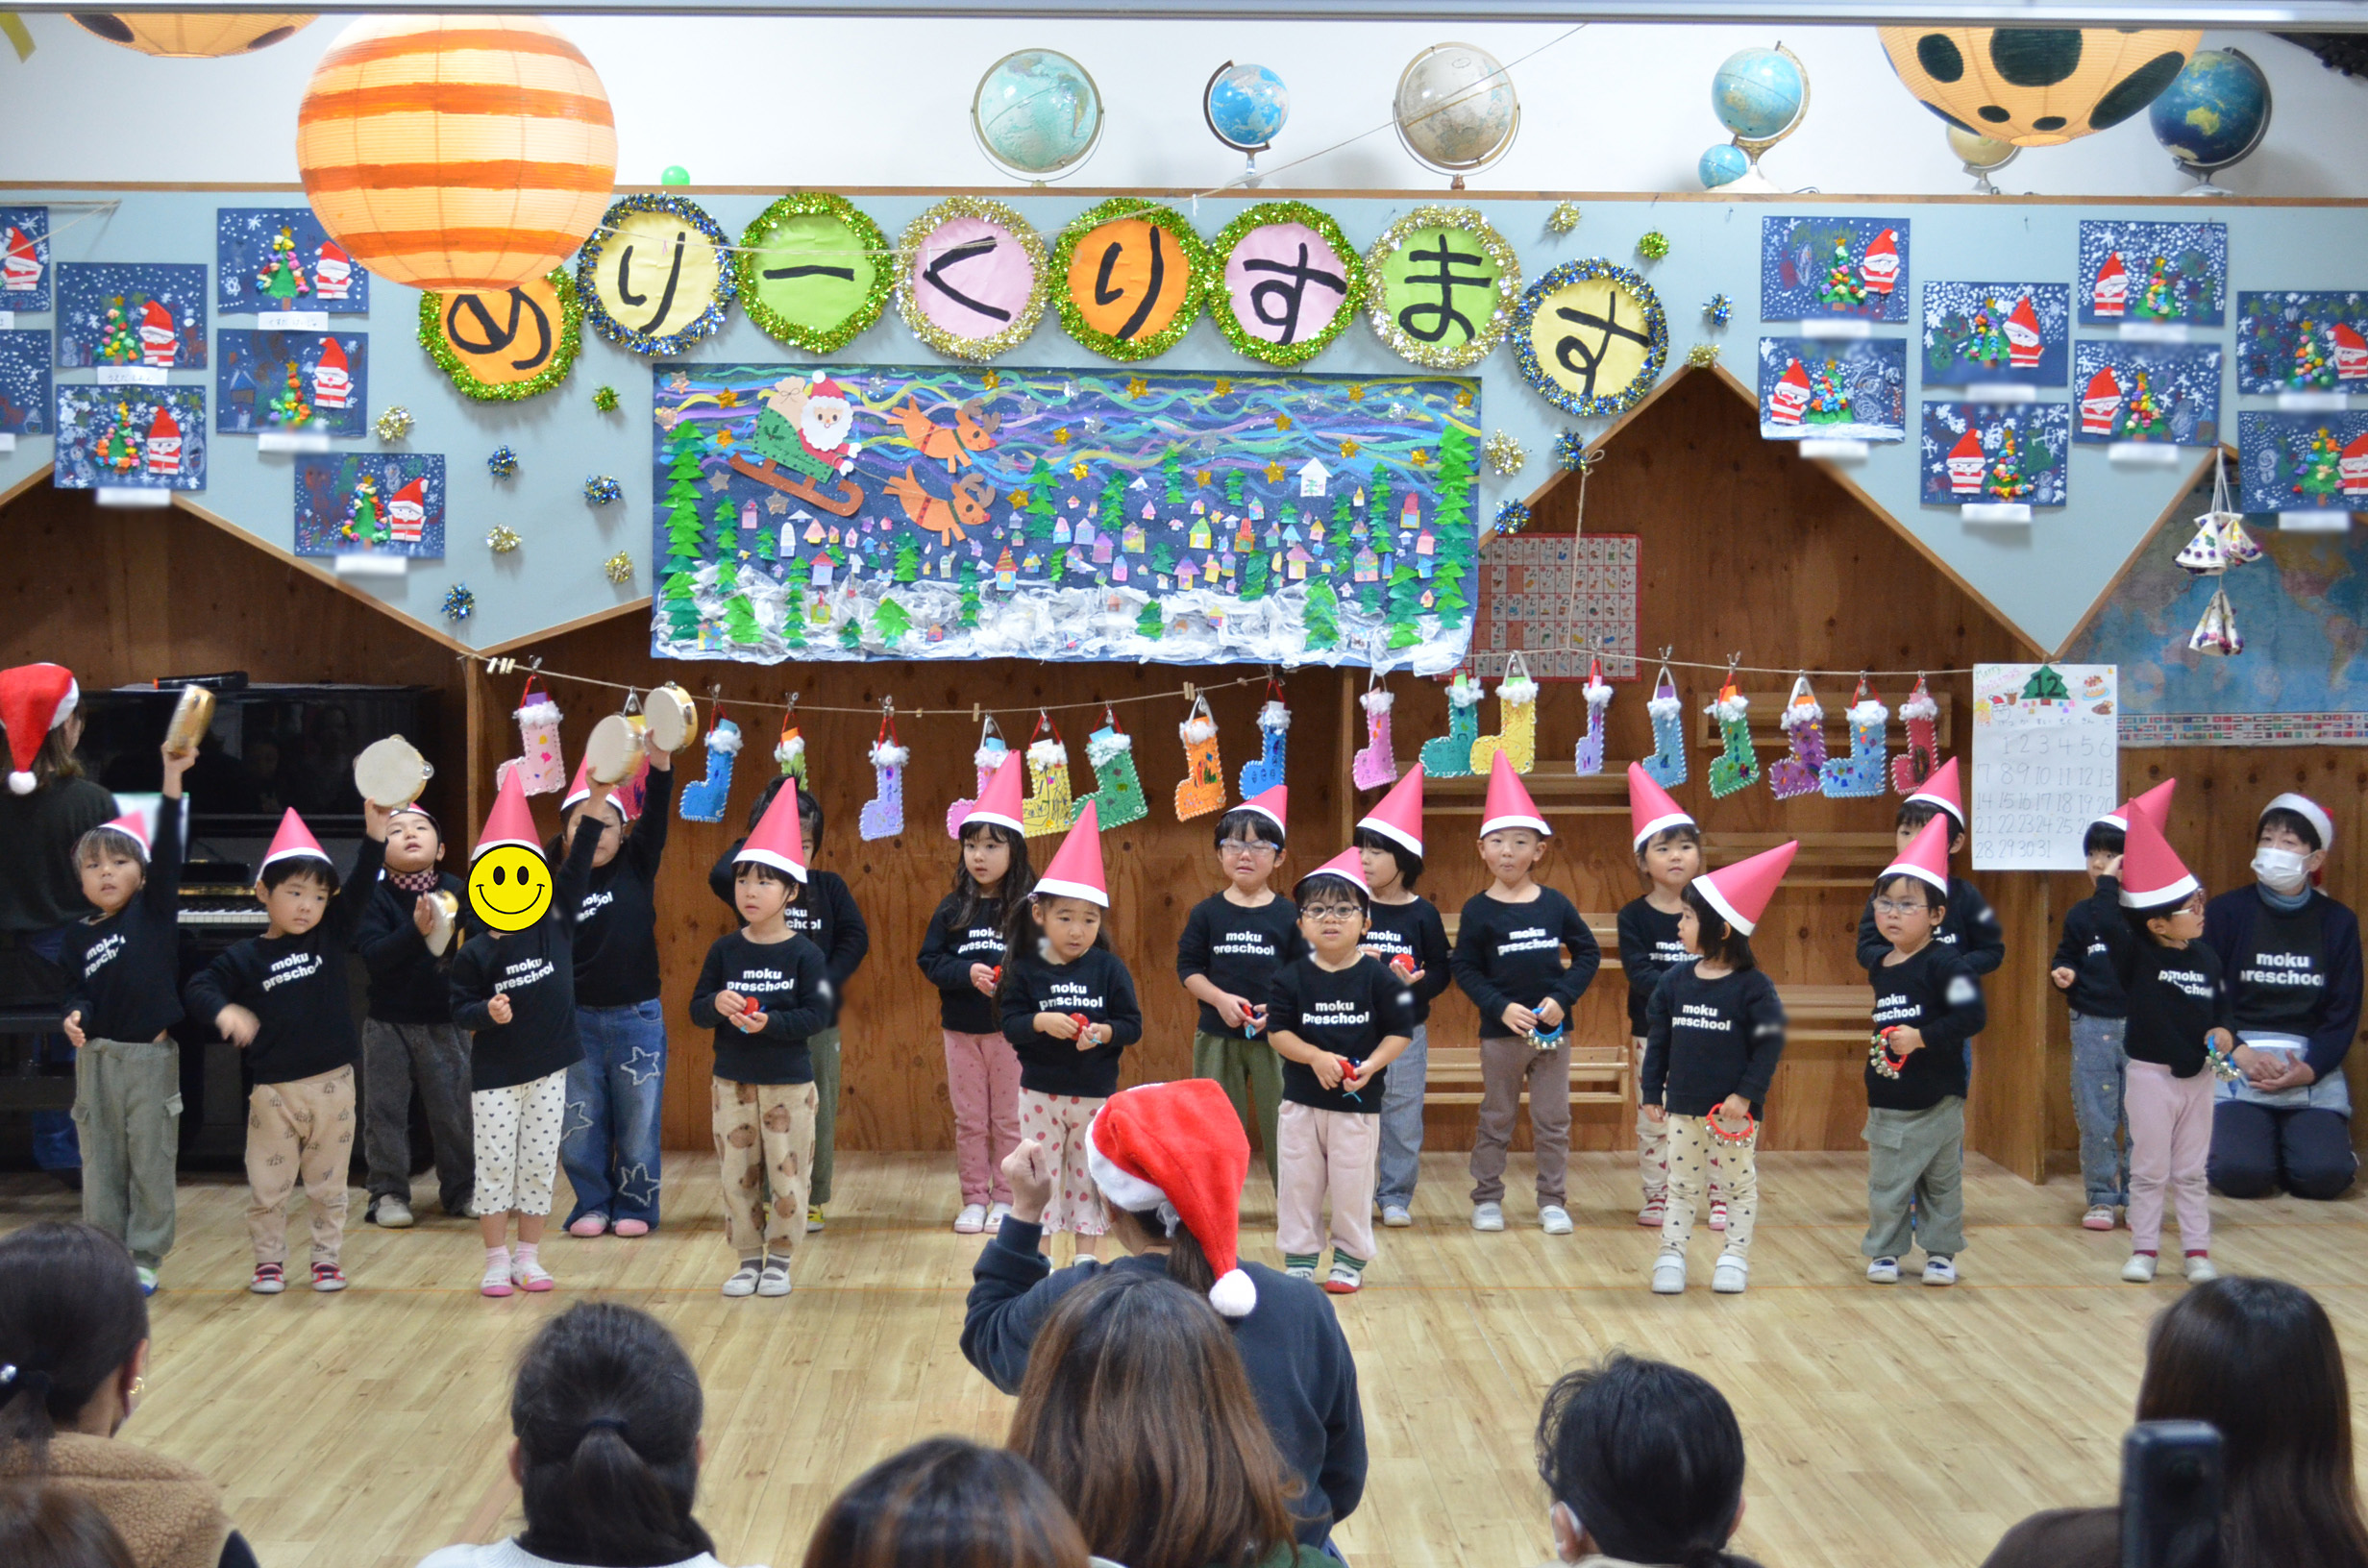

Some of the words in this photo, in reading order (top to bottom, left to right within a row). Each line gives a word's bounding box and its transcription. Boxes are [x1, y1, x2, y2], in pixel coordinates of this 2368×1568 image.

[2033, 674, 2061, 697] 12
[2003, 736, 2010, 754] 1
[2019, 734, 2030, 753] 2
[2038, 734, 2050, 754] 3
[2059, 738, 2072, 755] 4
[2081, 735, 2094, 756] 5
[2099, 737, 2113, 758] 6
[1977, 764, 1990, 783] 7
[2000, 762, 2013, 785] 8
[2017, 762, 2030, 784] 9
[2035, 766, 2051, 785] 10
[2059, 768, 2071, 786] 11
[2079, 767, 2093, 786] 12
[2098, 768, 2113, 787] 13
[1977, 793, 1992, 810] 14
[1999, 792, 2014, 809] 15
[2018, 793, 2031, 811] 16
[2035, 793, 2052, 811] 17
[2057, 792, 2073, 814] 18
[2079, 794, 2093, 814] 19
[2097, 796, 2113, 815] 20
[1975, 816, 1992, 834] 21
[1998, 814, 2014, 834] 22
[2018, 814, 2034, 834] 23
[2035, 815, 2053, 834] 24
[2057, 816, 2073, 834] 25
[1975, 840, 1994, 859] 28
[1998, 839, 2014, 859] 29
[2018, 839, 2034, 858] 30
[2037, 839, 2051, 859] 31
[783, 907, 808, 918] oku
[785, 918, 822, 930] chool
[1225, 930, 1263, 943] moku
[1367, 930, 1401, 943] moku
[1509, 927, 1546, 941] moku
[1497, 937, 1559, 956] preschool
[1655, 941, 1686, 951] mok
[271, 952, 309, 972] moku
[506, 957, 543, 975] moku
[2256, 952, 2310, 968] moku
[743, 968, 782, 980] moku
[1315, 999, 1355, 1012] moku
[1682, 1004, 1718, 1017] moku
[1302, 1011, 1369, 1025] preschool
[1871, 1004, 1921, 1023] reschool
[1671, 1017, 1731, 1031] preschool
